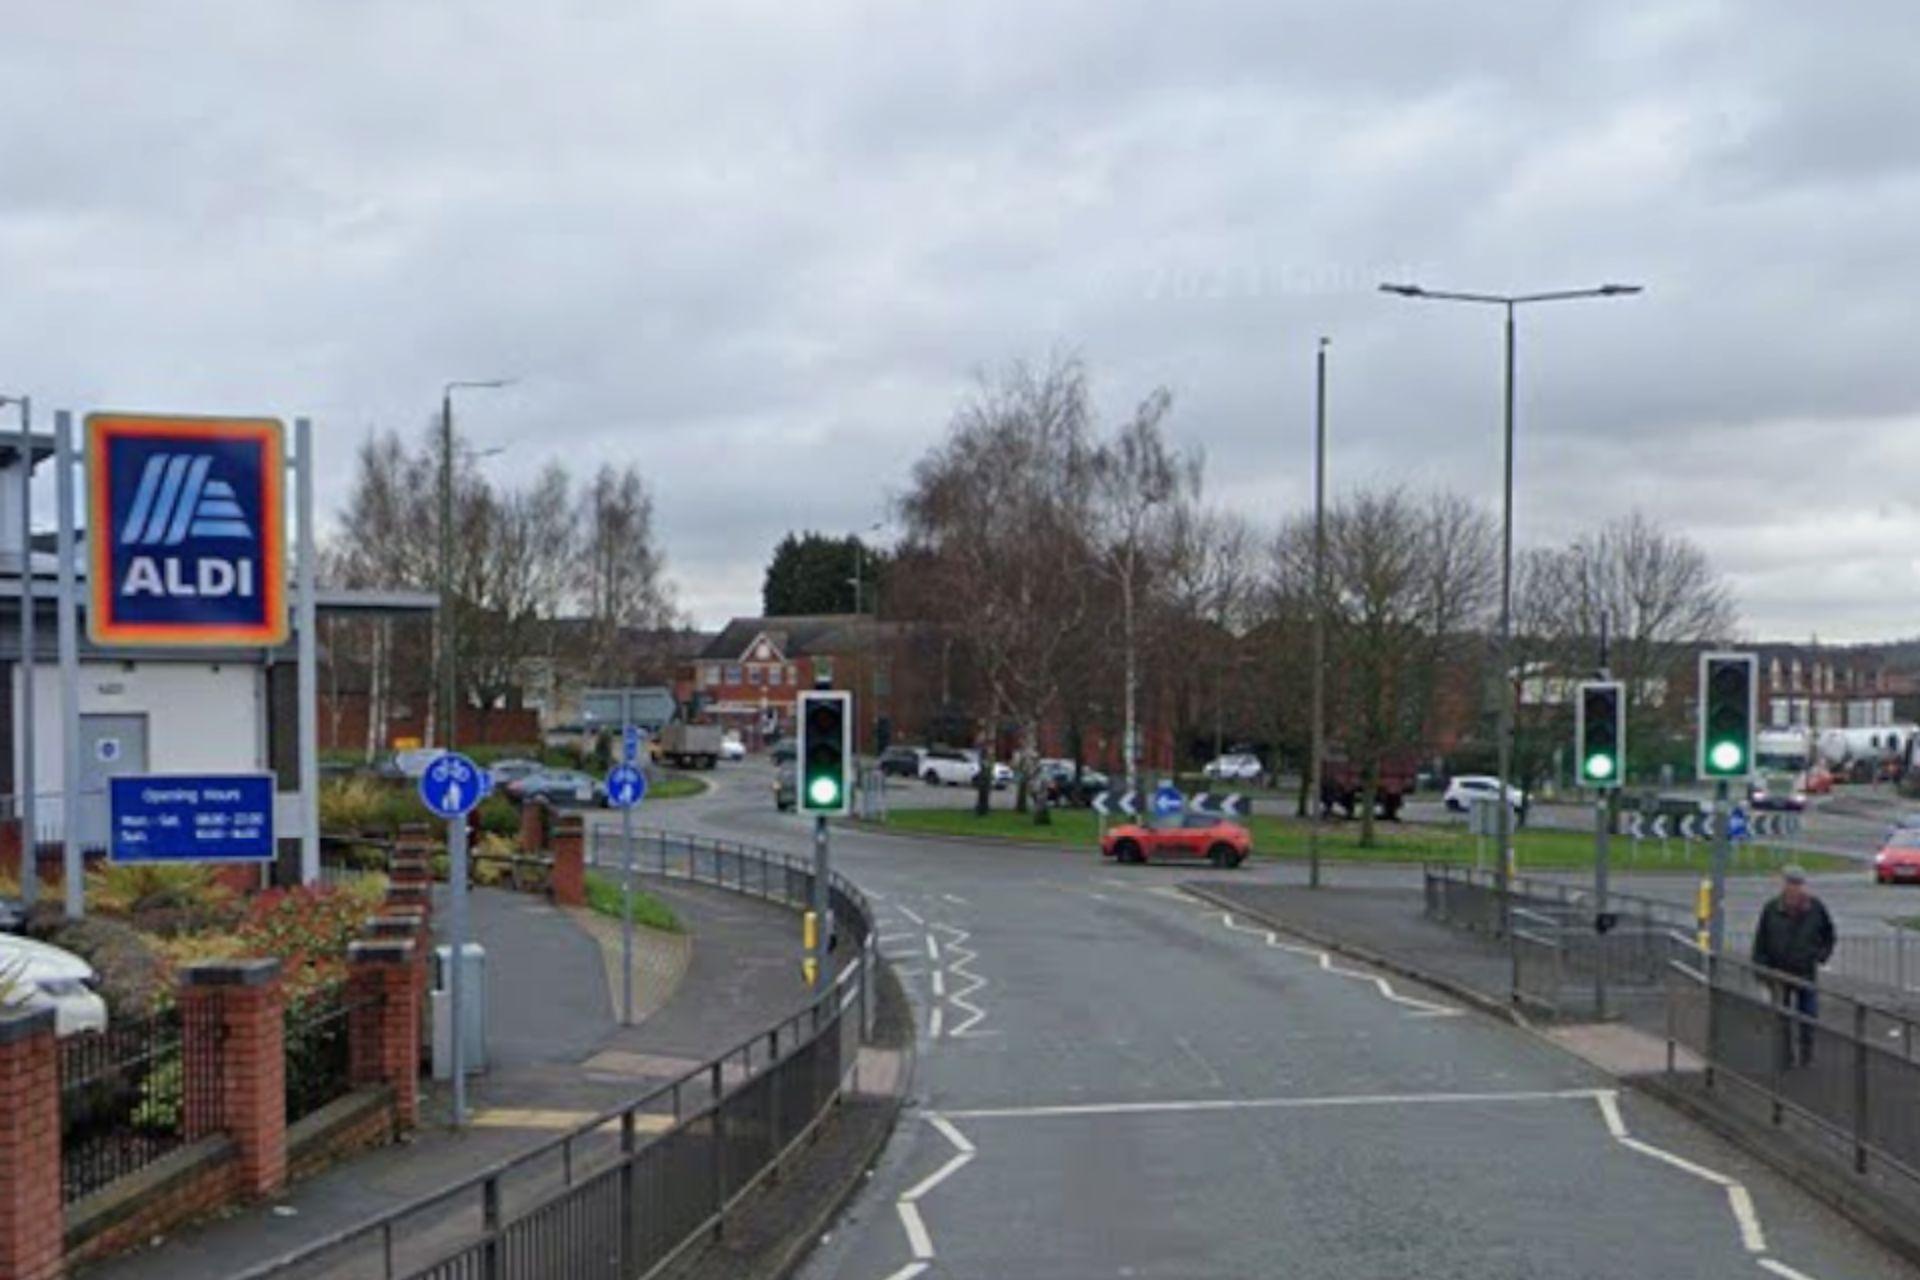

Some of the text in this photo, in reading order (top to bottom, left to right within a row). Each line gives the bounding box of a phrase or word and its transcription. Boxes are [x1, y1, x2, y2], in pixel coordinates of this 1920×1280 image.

[122, 556, 253, 597] ALDI
[141, 788, 241, 804] Opening Hours
